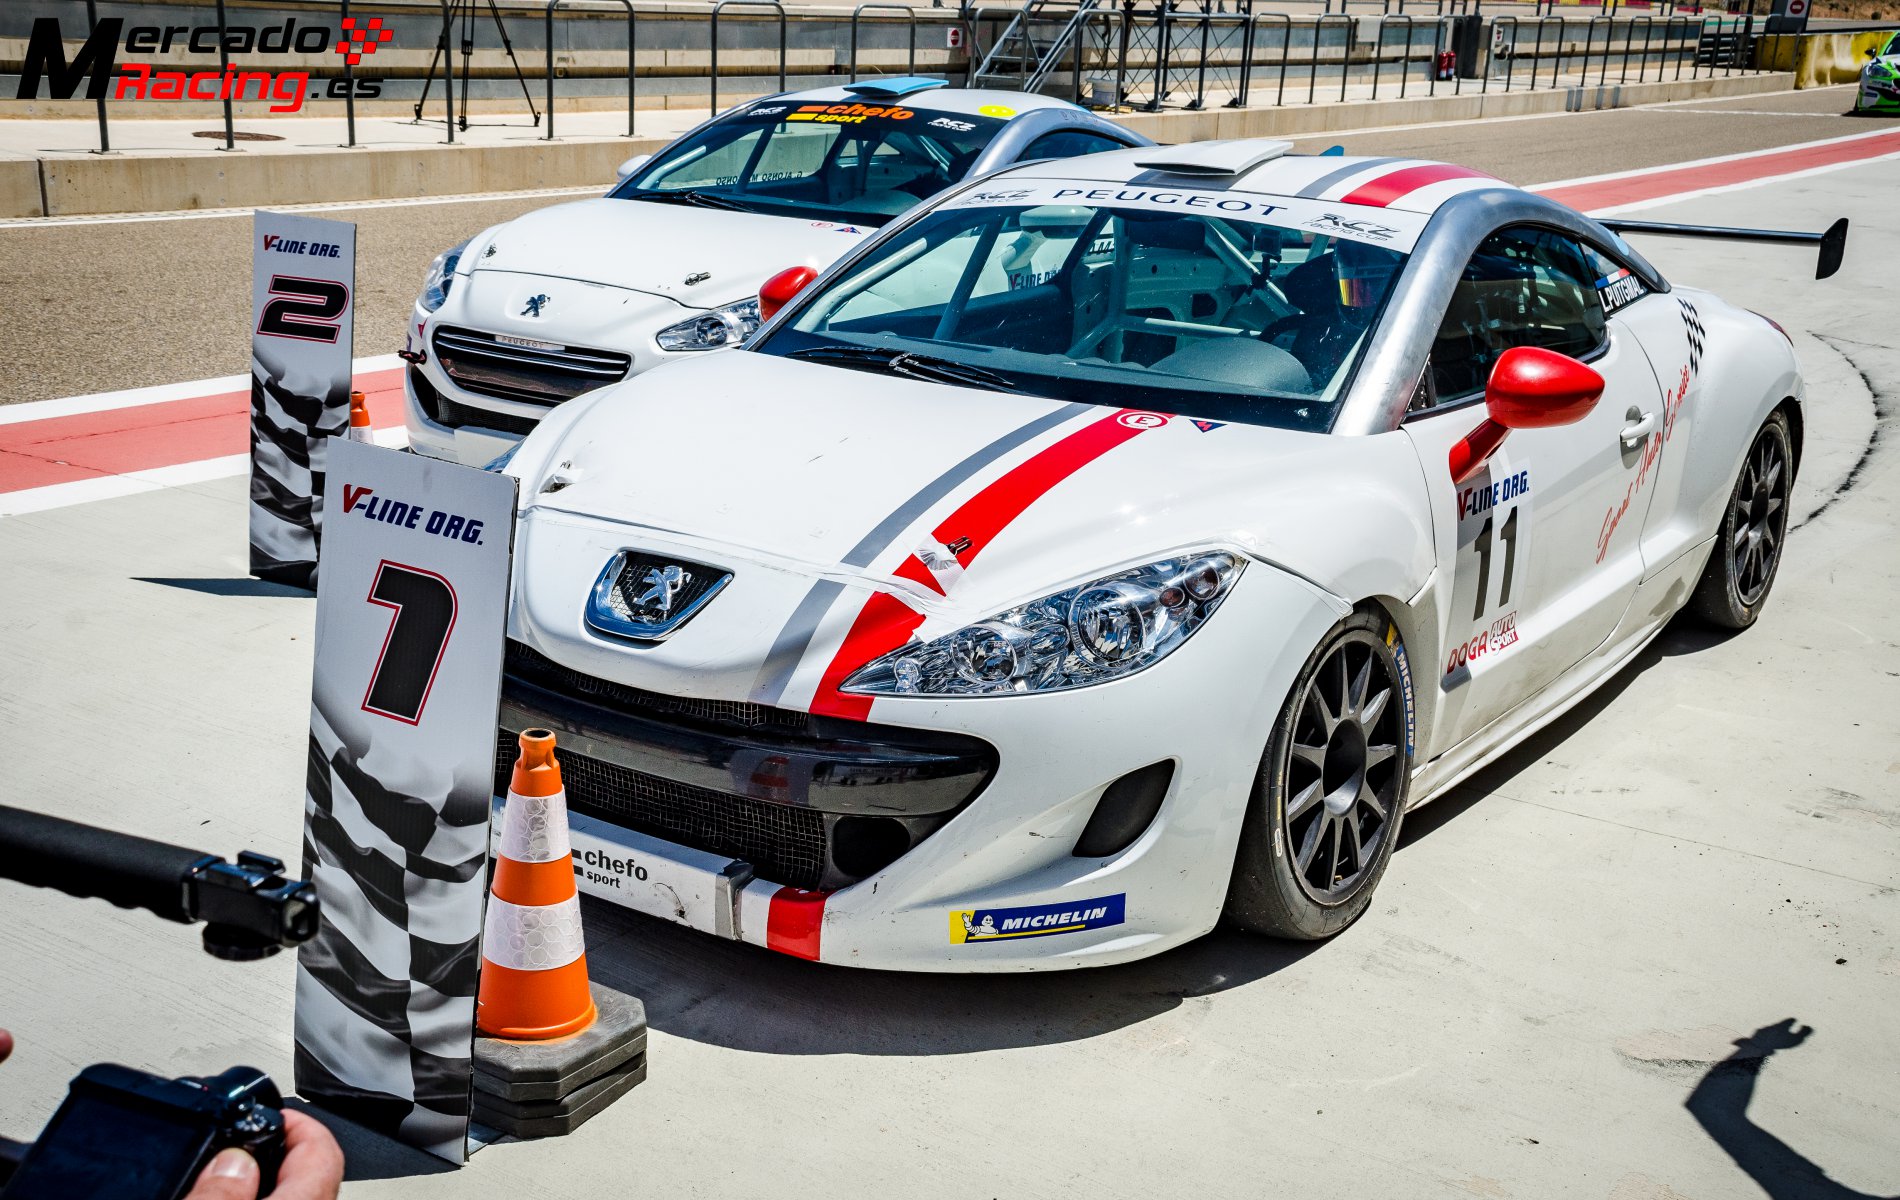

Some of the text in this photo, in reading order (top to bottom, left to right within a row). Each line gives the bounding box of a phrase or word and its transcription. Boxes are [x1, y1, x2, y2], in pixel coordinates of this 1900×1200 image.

[814, 114, 867, 125] sport
[826, 103, 915, 120] chefo
[1052, 188, 1289, 217] PEUGEOT
[1314, 212, 1402, 240] RCZ
[263, 234, 341, 259] V-LINE ORG.
[256, 273, 350, 345] 2
[501, 335, 545, 348] PEUGEOT
[1457, 469, 1530, 522] V-LINE ORG.
[343, 483, 484, 546] V-LINE ORG.
[1473, 505, 1518, 622] 11
[1491, 612, 1518, 638] AUTO
[361, 558, 459, 727] 1
[1446, 630, 1487, 675] DOGA
[1490, 629, 1519, 656] SPORT
[1396, 651, 1414, 747] MICHELIN
[584, 849, 648, 882] chefo
[586, 870, 621, 889] sport
[1001, 906, 1108, 931] MICHELIN
